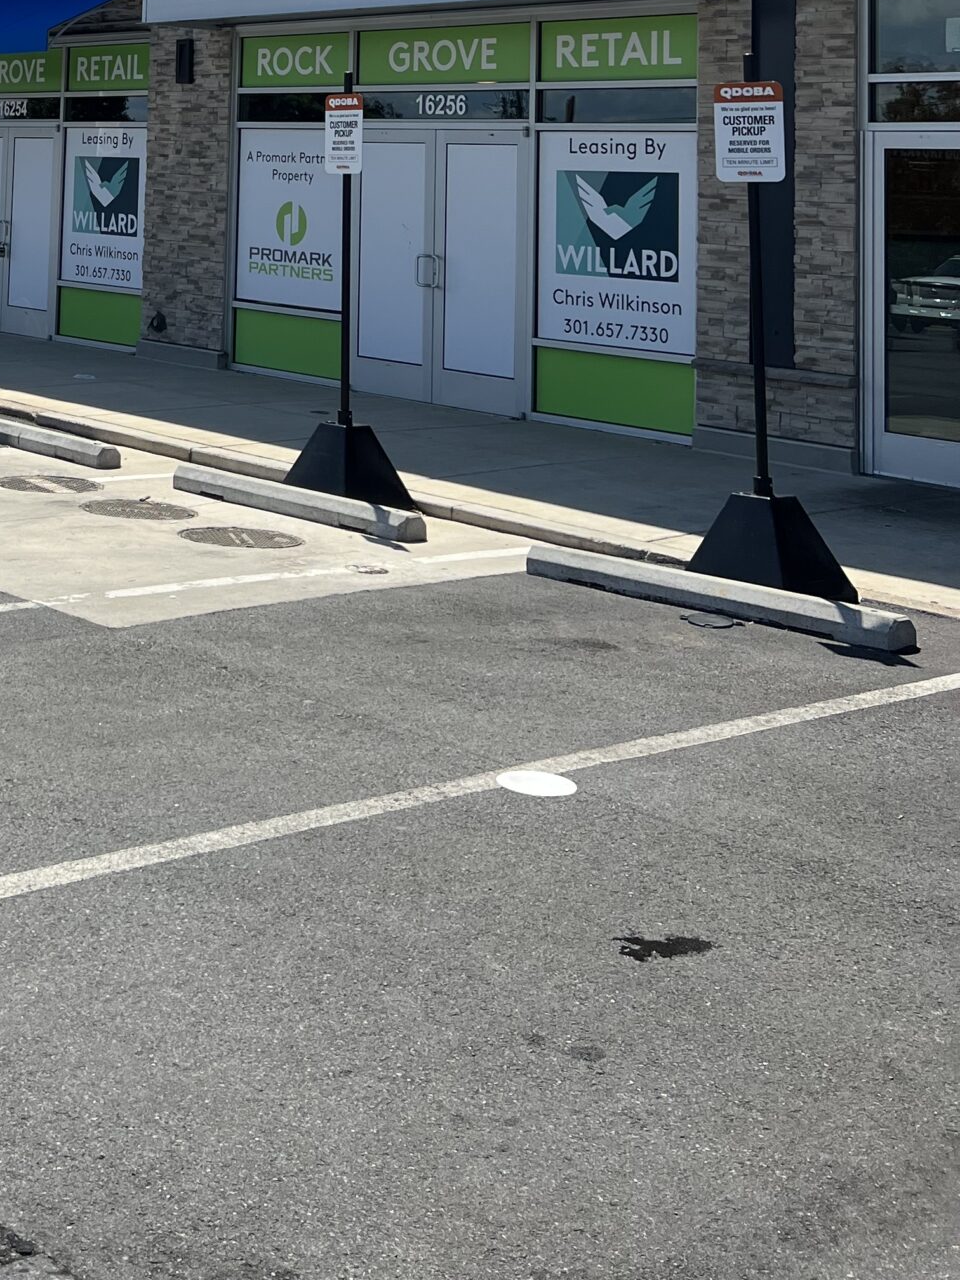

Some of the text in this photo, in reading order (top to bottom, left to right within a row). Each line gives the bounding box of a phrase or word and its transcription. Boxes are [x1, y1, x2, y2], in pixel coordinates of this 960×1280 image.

[257, 30, 682, 77] ROCK GROVE RETAIL
[76, 54, 143, 82] RETAIL
[329, 97, 358, 108] QDOBA
[720, 87, 774, 99] QDOBA
[0, 99, 27, 118] 16254
[416, 95, 466, 116] 16256
[329, 120, 358, 129] CUSTOMER
[722, 115, 775, 126] CUSTOMER
[334, 129, 353, 138] PICKUP
[732, 126, 766, 136] PICKUP
[81, 132, 134, 150] Leasing By
[569, 138, 667, 160] Leasing By
[246, 151, 325, 165] A Promark Partn
[271, 168, 314, 185] Property
[73, 210, 138, 235] WILLARD
[69, 243, 139, 262] Chris Wilkinson
[248, 246, 333, 267] PROMARK
[557, 244, 679, 278] WILLARD
[74, 264, 132, 283] 301.657.7330
[248, 261, 334, 282] PARTNERS
[552, 288, 683, 316] Chris Wilkinson
[563, 318, 670, 344] 301.657.7330
